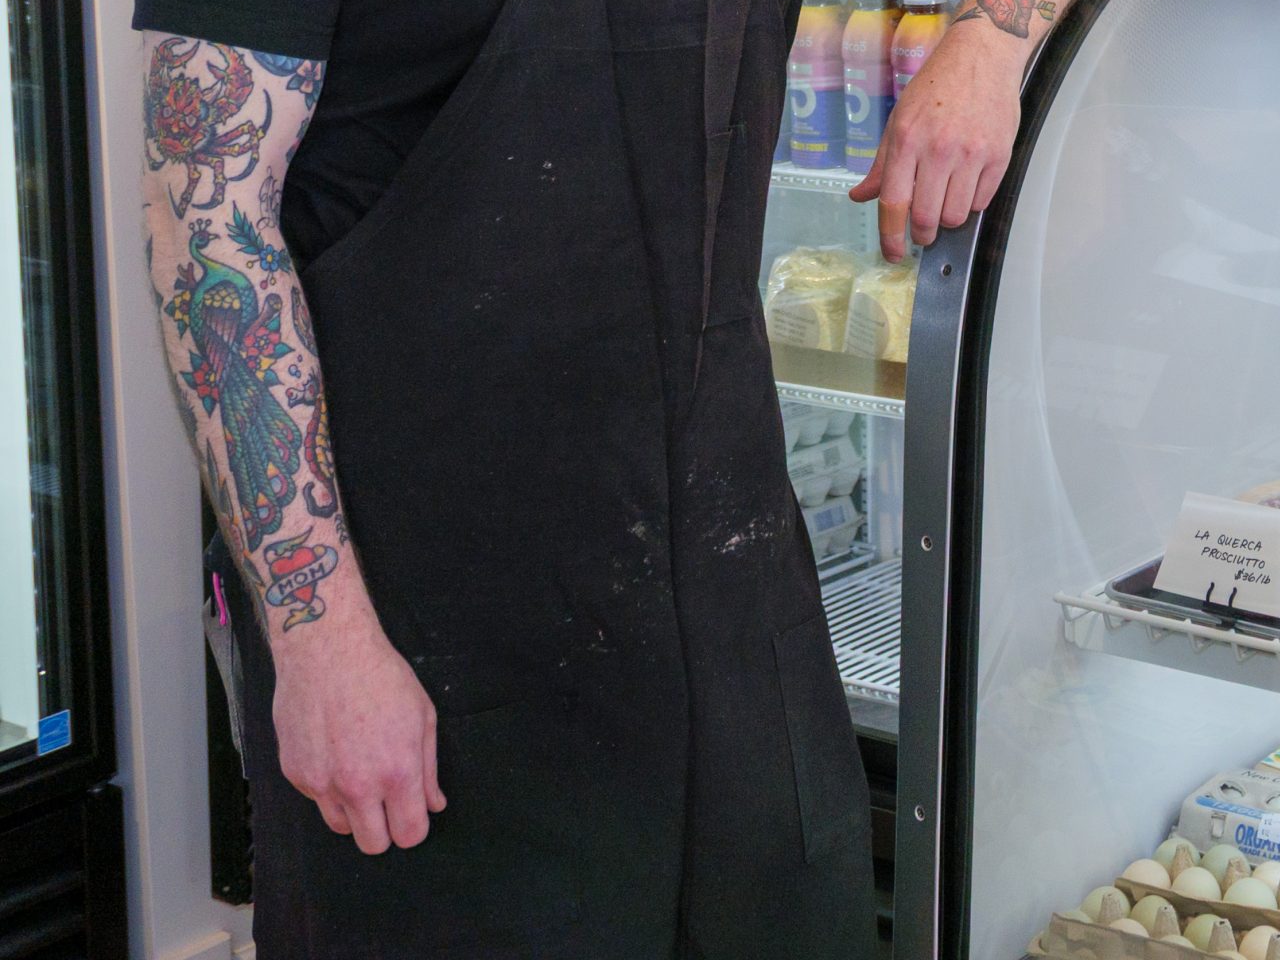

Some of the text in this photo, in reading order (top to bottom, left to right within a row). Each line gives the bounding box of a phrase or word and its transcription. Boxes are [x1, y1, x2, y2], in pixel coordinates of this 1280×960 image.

[1194, 529, 1263, 552] LA QUERCA
[1201, 546, 1266, 570] PROSCIUTTO
[277, 562, 326, 595] MOM
[1234, 568, 1271, 585] $36/lb
[1241, 770, 1270, 781] New
